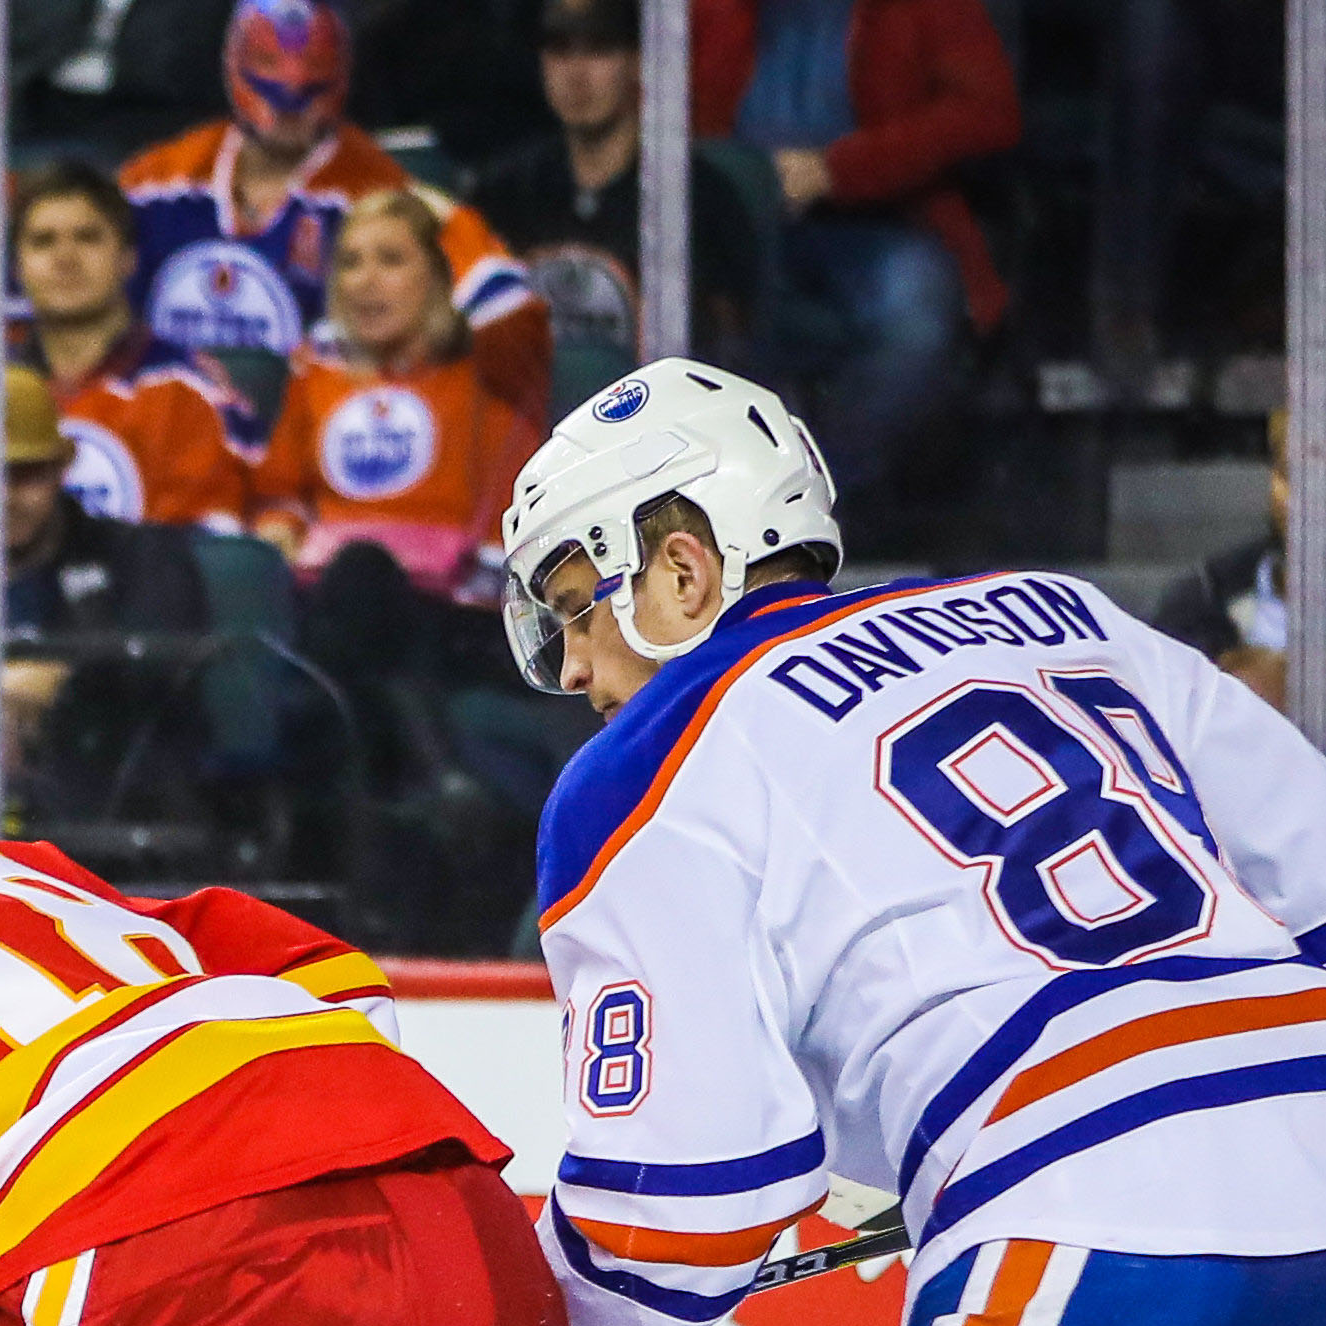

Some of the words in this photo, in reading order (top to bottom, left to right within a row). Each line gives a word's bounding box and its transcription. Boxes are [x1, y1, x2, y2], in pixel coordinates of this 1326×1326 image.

[770, 577, 1110, 724] DAVIDSON
[561, 980, 653, 1119] 8
[754, 1251, 829, 1290] CC
